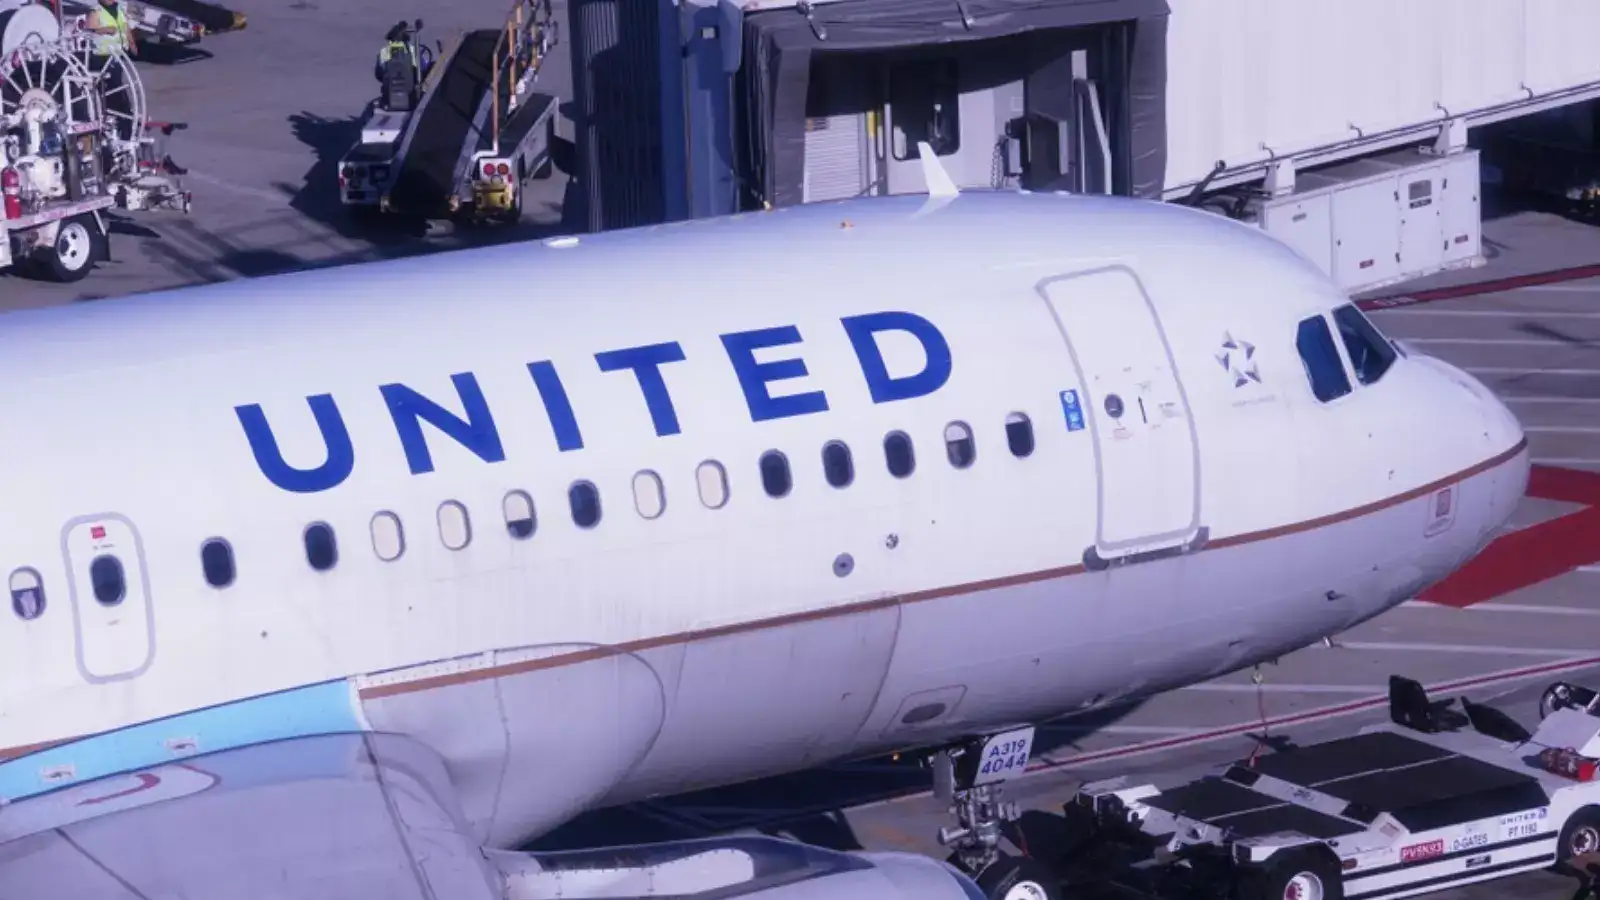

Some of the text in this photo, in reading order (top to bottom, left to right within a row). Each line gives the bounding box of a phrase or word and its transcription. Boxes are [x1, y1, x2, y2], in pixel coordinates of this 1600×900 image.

[234, 311, 952, 493] UNITED
[989, 739, 1026, 758] A319
[981, 752, 1026, 773] 4044
